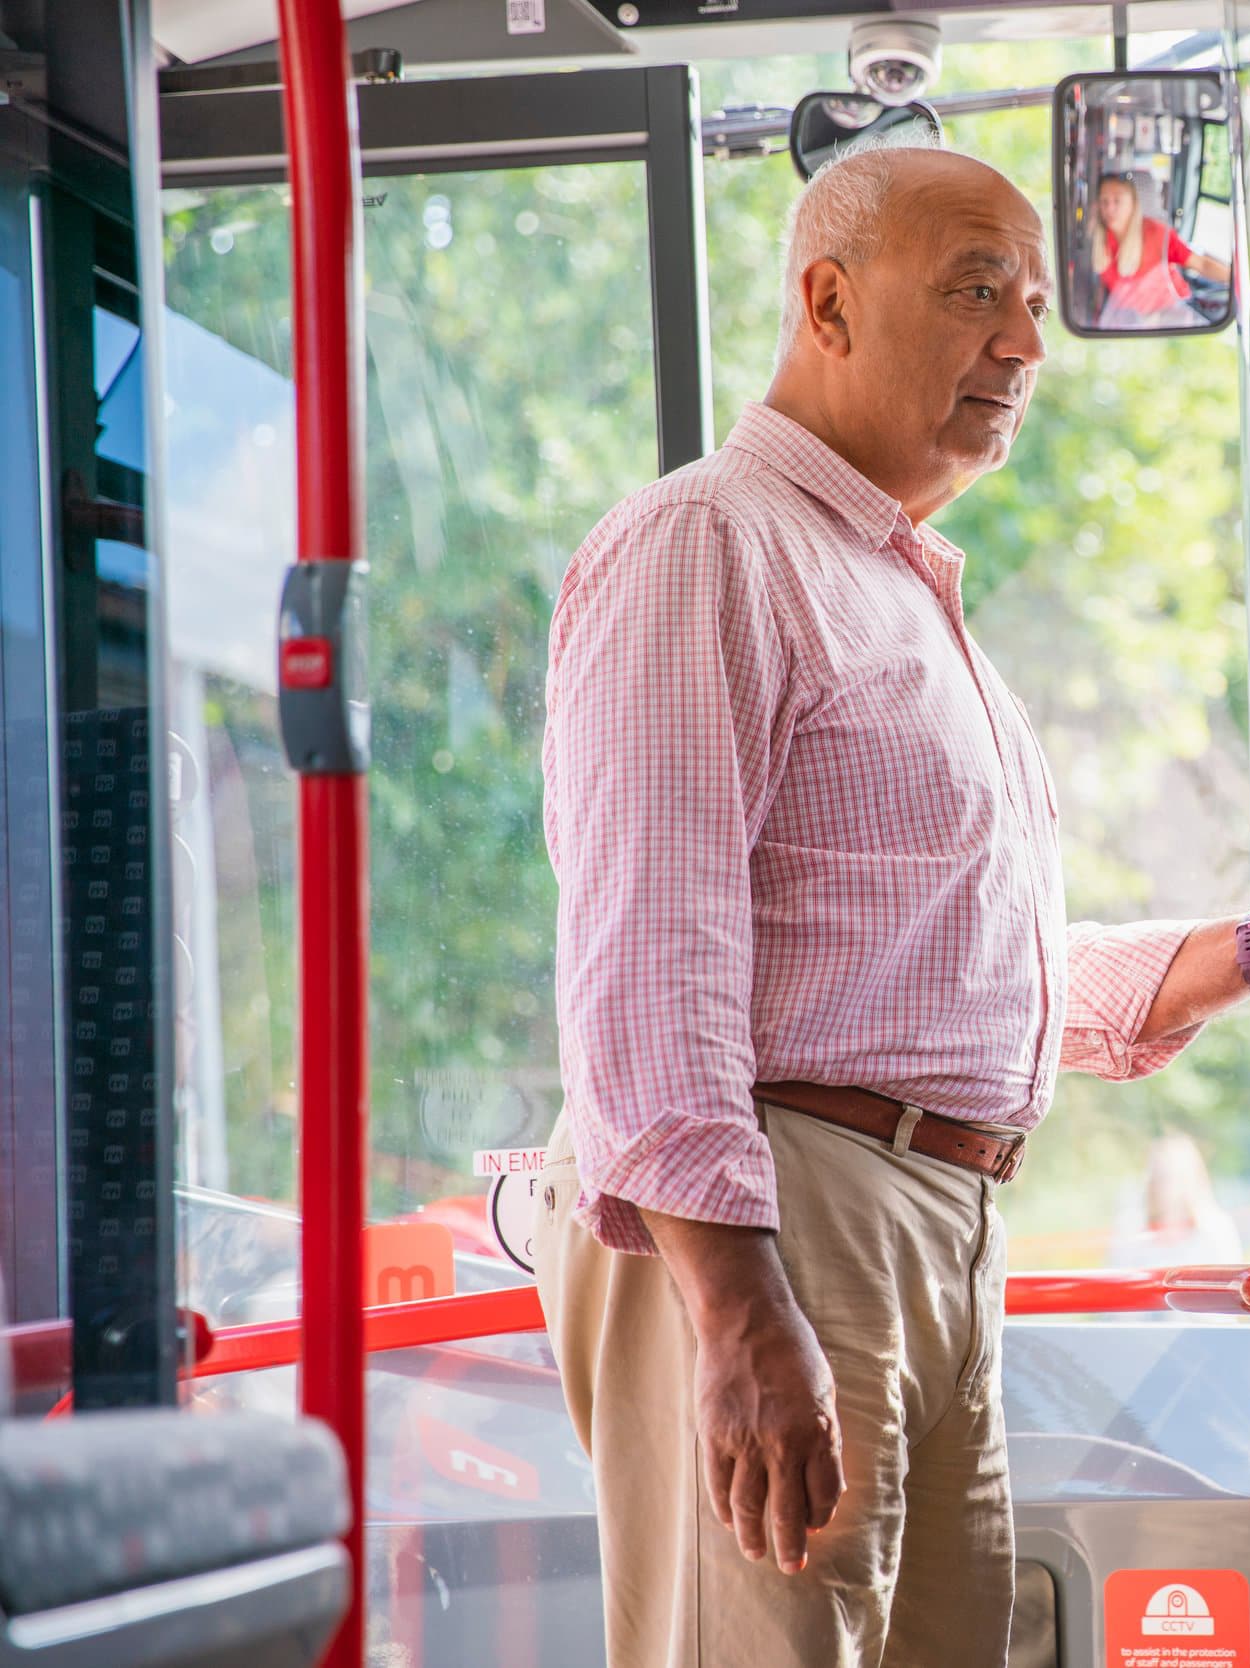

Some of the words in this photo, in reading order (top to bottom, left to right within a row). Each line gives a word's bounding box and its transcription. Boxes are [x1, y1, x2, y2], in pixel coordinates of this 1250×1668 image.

[483, 1154, 501, 1172] IN
[377, 1266, 434, 1305] m
[1161, 1620, 1195, 1632] CCTV
[1120, 1648, 1132, 1657] to
[1133, 1647, 1160, 1657] assist
[1162, 1647, 1171, 1657] in
[1172, 1647, 1187, 1657] the
[1188, 1647, 1237, 1658] protection
[1124, 1657, 1136, 1667] of
[1136, 1657, 1159, 1667] staff
[1160, 1658, 1178, 1667] and
[1179, 1659, 1233, 1668] passengers
